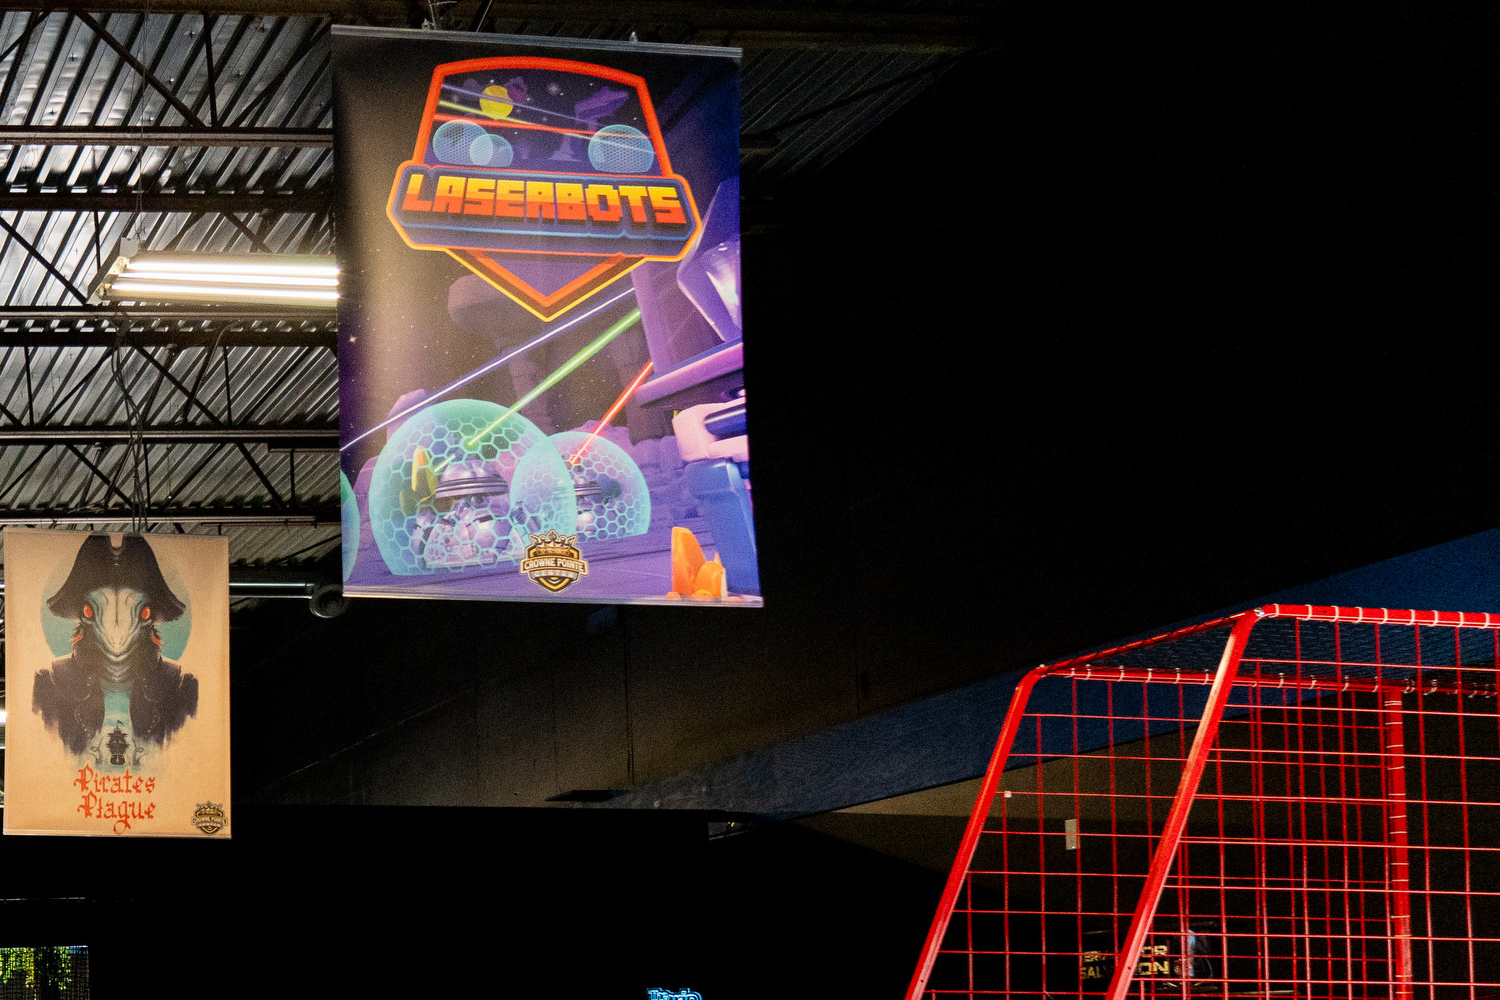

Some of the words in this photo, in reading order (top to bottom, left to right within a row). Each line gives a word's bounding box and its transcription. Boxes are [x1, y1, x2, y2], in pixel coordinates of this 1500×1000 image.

[402, 172, 688, 226] LASERBOTS
[524, 558, 556, 570] CROWNE
[557, 558, 584, 572] POINTE
[73, 764, 156, 793] Pirates
[77, 791, 156, 835] Plague
